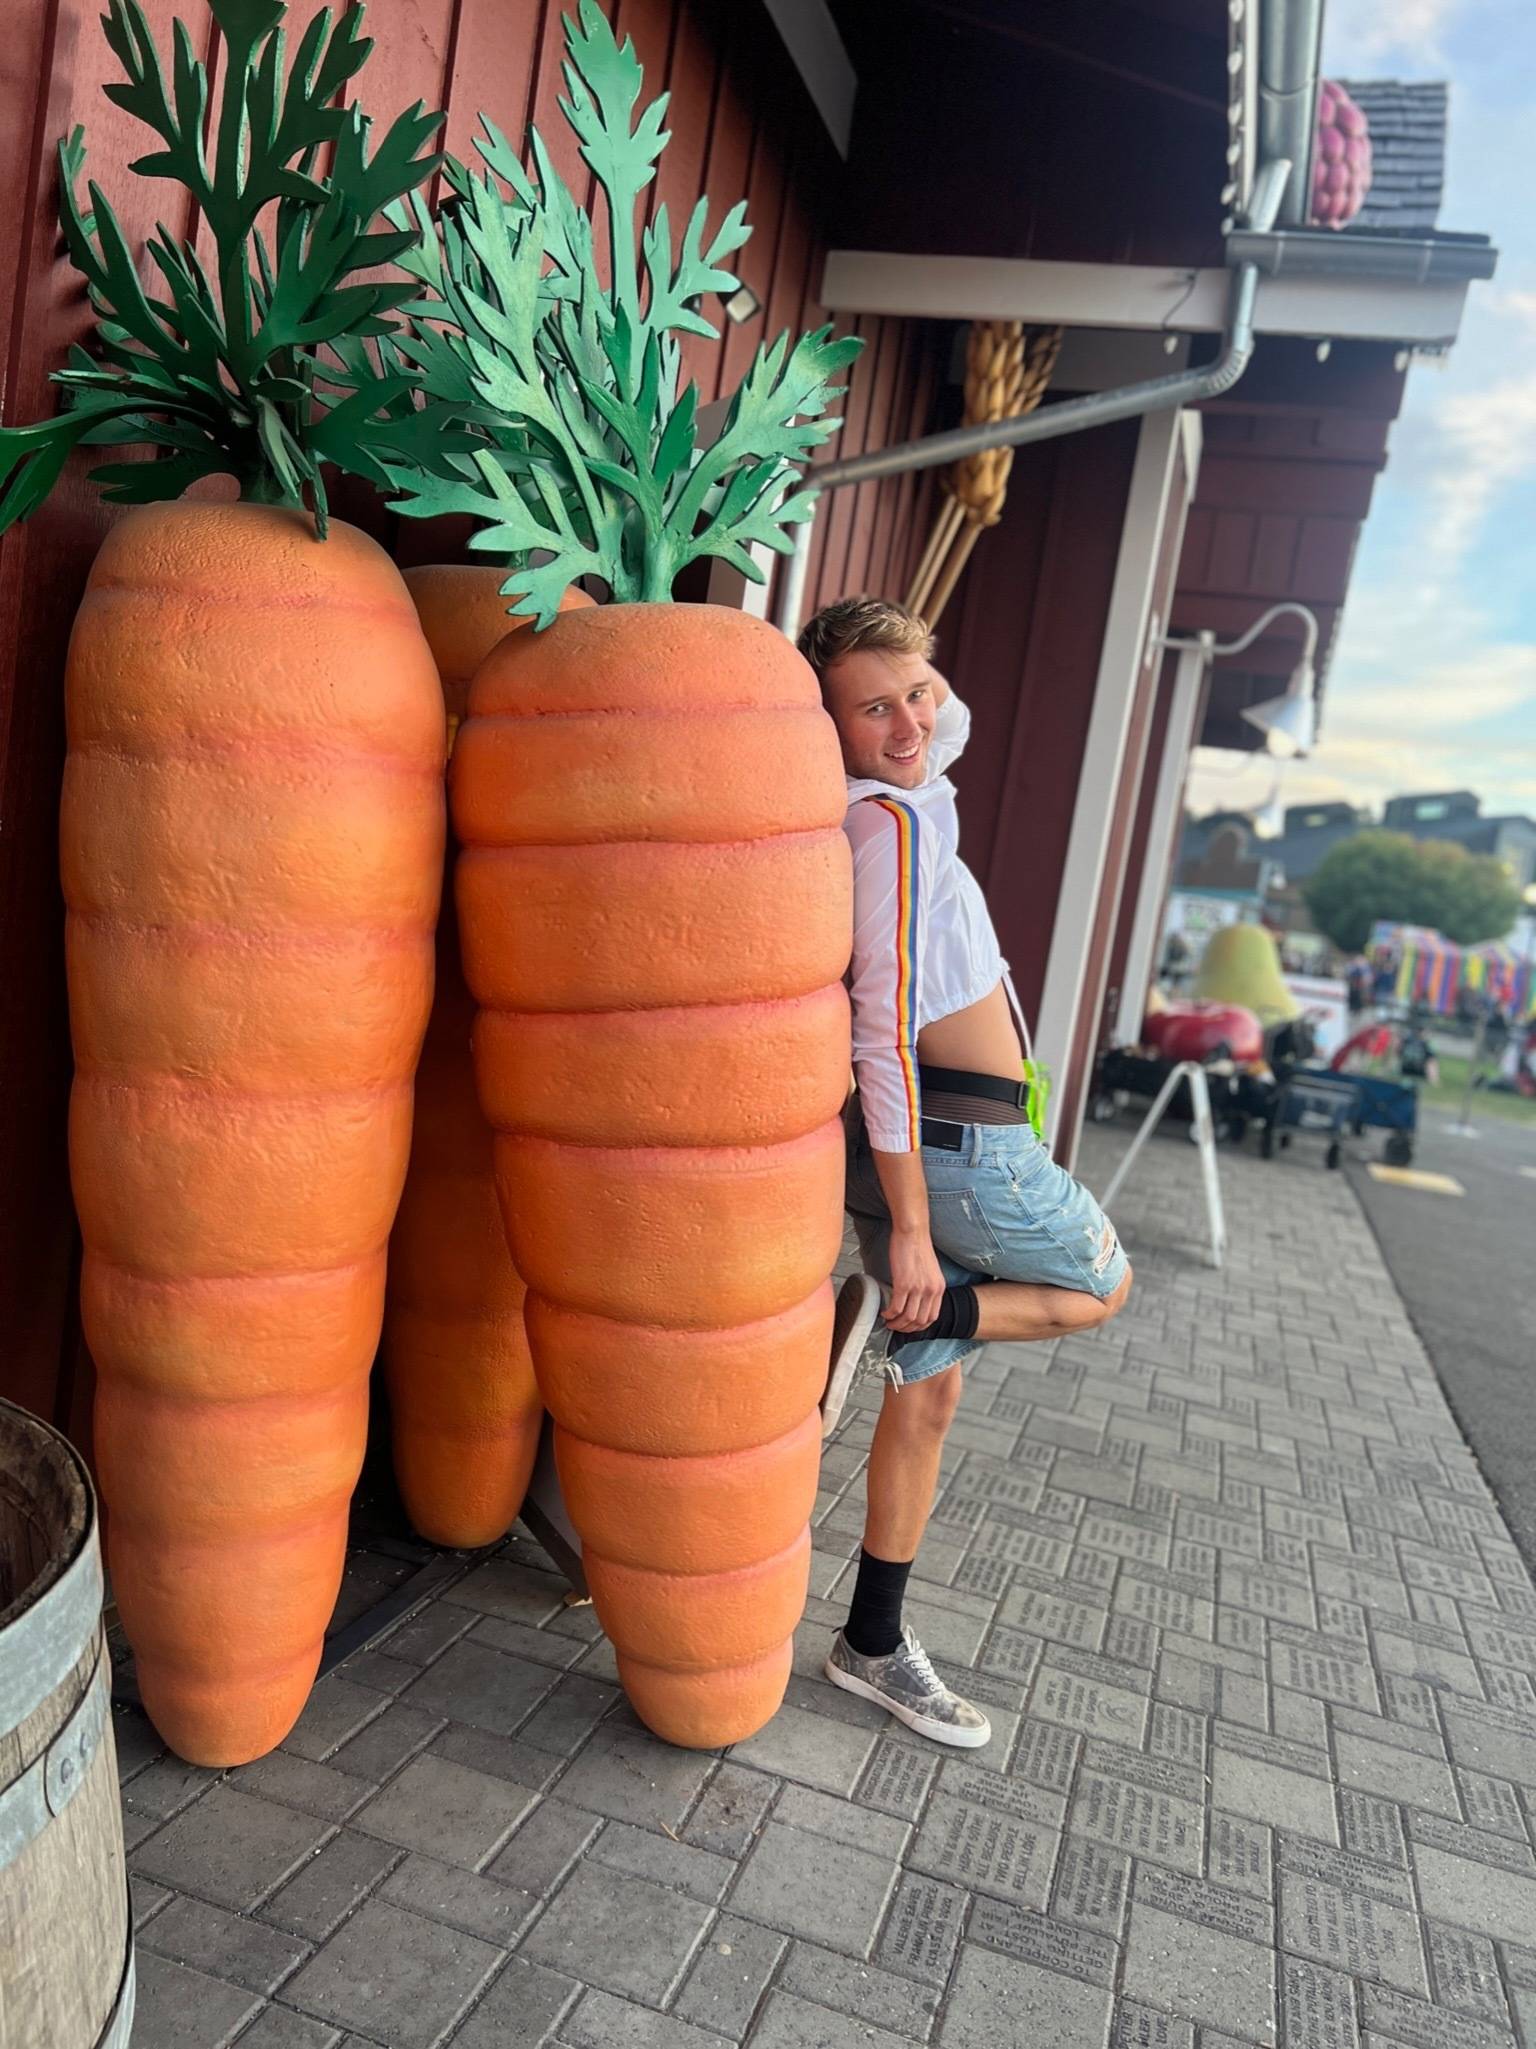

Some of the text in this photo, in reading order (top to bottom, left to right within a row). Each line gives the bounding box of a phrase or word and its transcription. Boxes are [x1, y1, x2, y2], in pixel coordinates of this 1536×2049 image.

[944, 1806, 972, 1841] ANGELA
[1102, 1806, 1117, 1839] ALWAYS
[1157, 1817, 1169, 1840] LOVE
[954, 1841, 978, 1873] HAPPY
[972, 1819, 1005, 1879] ALL BECAUSE
[992, 1826, 1021, 1884] TWO PEOPLE
[1018, 1831, 1037, 1856] LOVE
[1082, 1843, 1094, 1868] MARK
[937, 1849, 955, 1867] TIM
[1010, 1868, 1028, 1890] FELL
[1078, 1868, 1091, 1891] YOUR
[1071, 1889, 1086, 1917] MAKE
[1192, 1890, 1240, 1912] PROUD
[1324, 1898, 1337, 1926] ALICE
[1340, 1889, 1354, 1913] LOVE
[891, 1886, 922, 1956] VALERIE EAVES
[905, 1885, 938, 1967] FRANKLIN PIERCE
[923, 1895, 953, 1968] CLASS OF 2020
[977, 1920, 994, 1932] AT
[1007, 1908, 1079, 1939] LOVE MOM
[984, 1933, 1013, 1950] AND
[1080, 1943, 1107, 1959] THE
[1326, 1925, 1340, 1953] MARY
[1046, 1942, 1103, 1969] GETTING
[1346, 1937, 1361, 1969] TRACY
[1073, 1963, 1090, 1976] TO
[1155, 2017, 1168, 2044] LOVE
